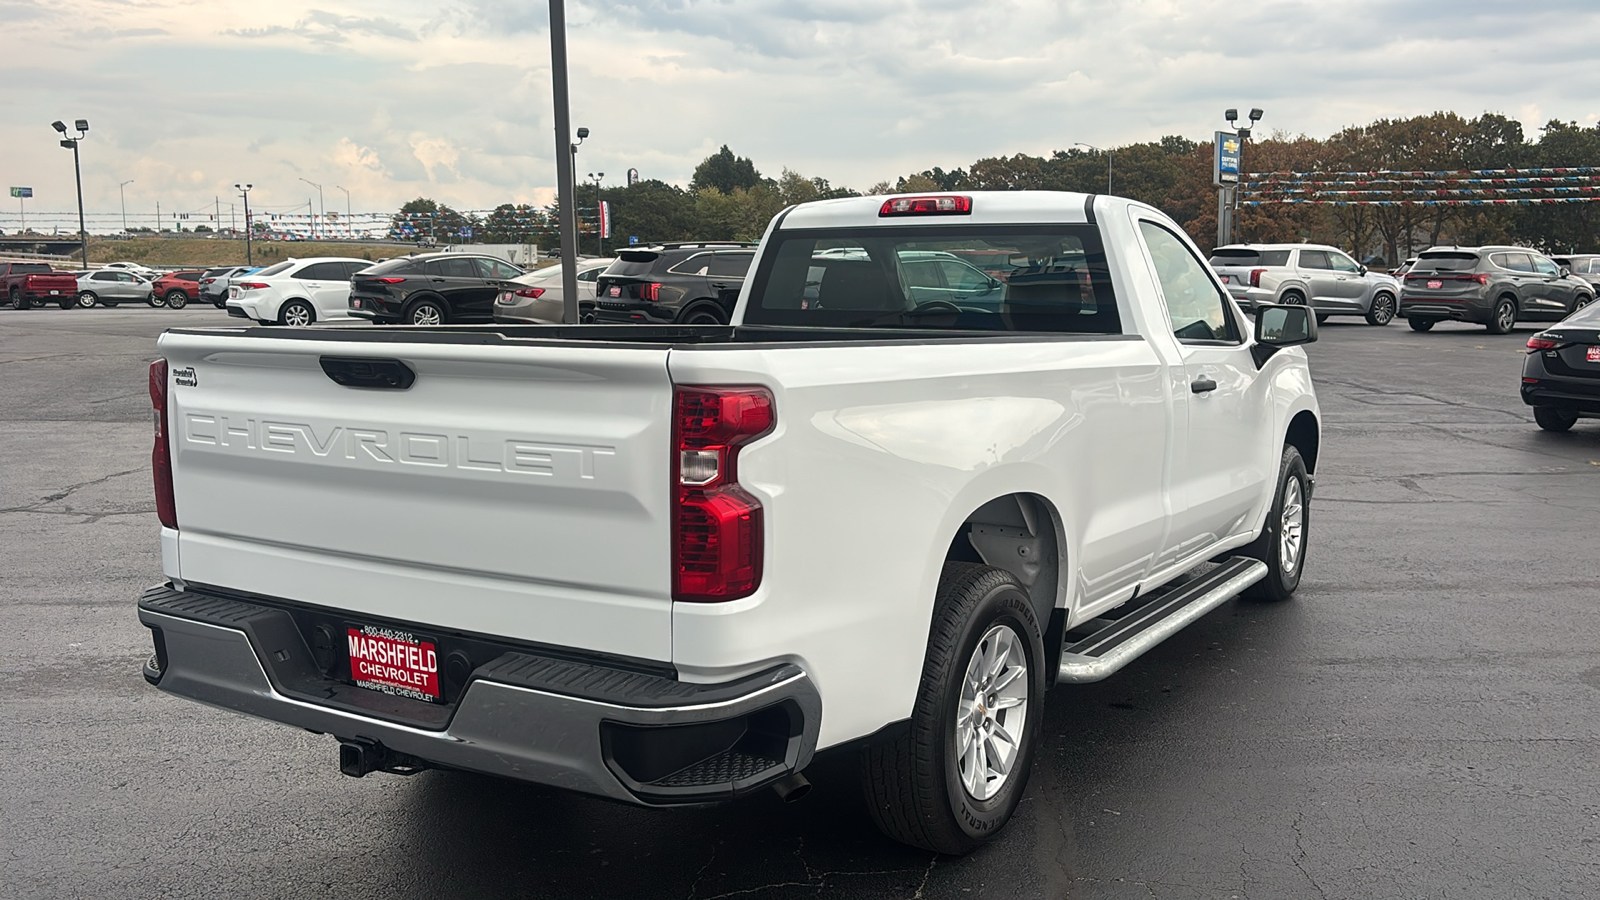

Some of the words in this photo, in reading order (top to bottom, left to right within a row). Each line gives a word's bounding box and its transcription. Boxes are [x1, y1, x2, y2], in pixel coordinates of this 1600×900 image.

[185, 413, 616, 480] CHEVROLET
[364, 625, 414, 642] 800-440-2312
[348, 635, 438, 673] MARSHFIELD
[359, 661, 429, 686] CHEVROLET
[356, 680, 396, 696] MARSHFIELD
[395, 687, 434, 702] CHEVROLET
[960, 801, 1002, 832] GENERAL
